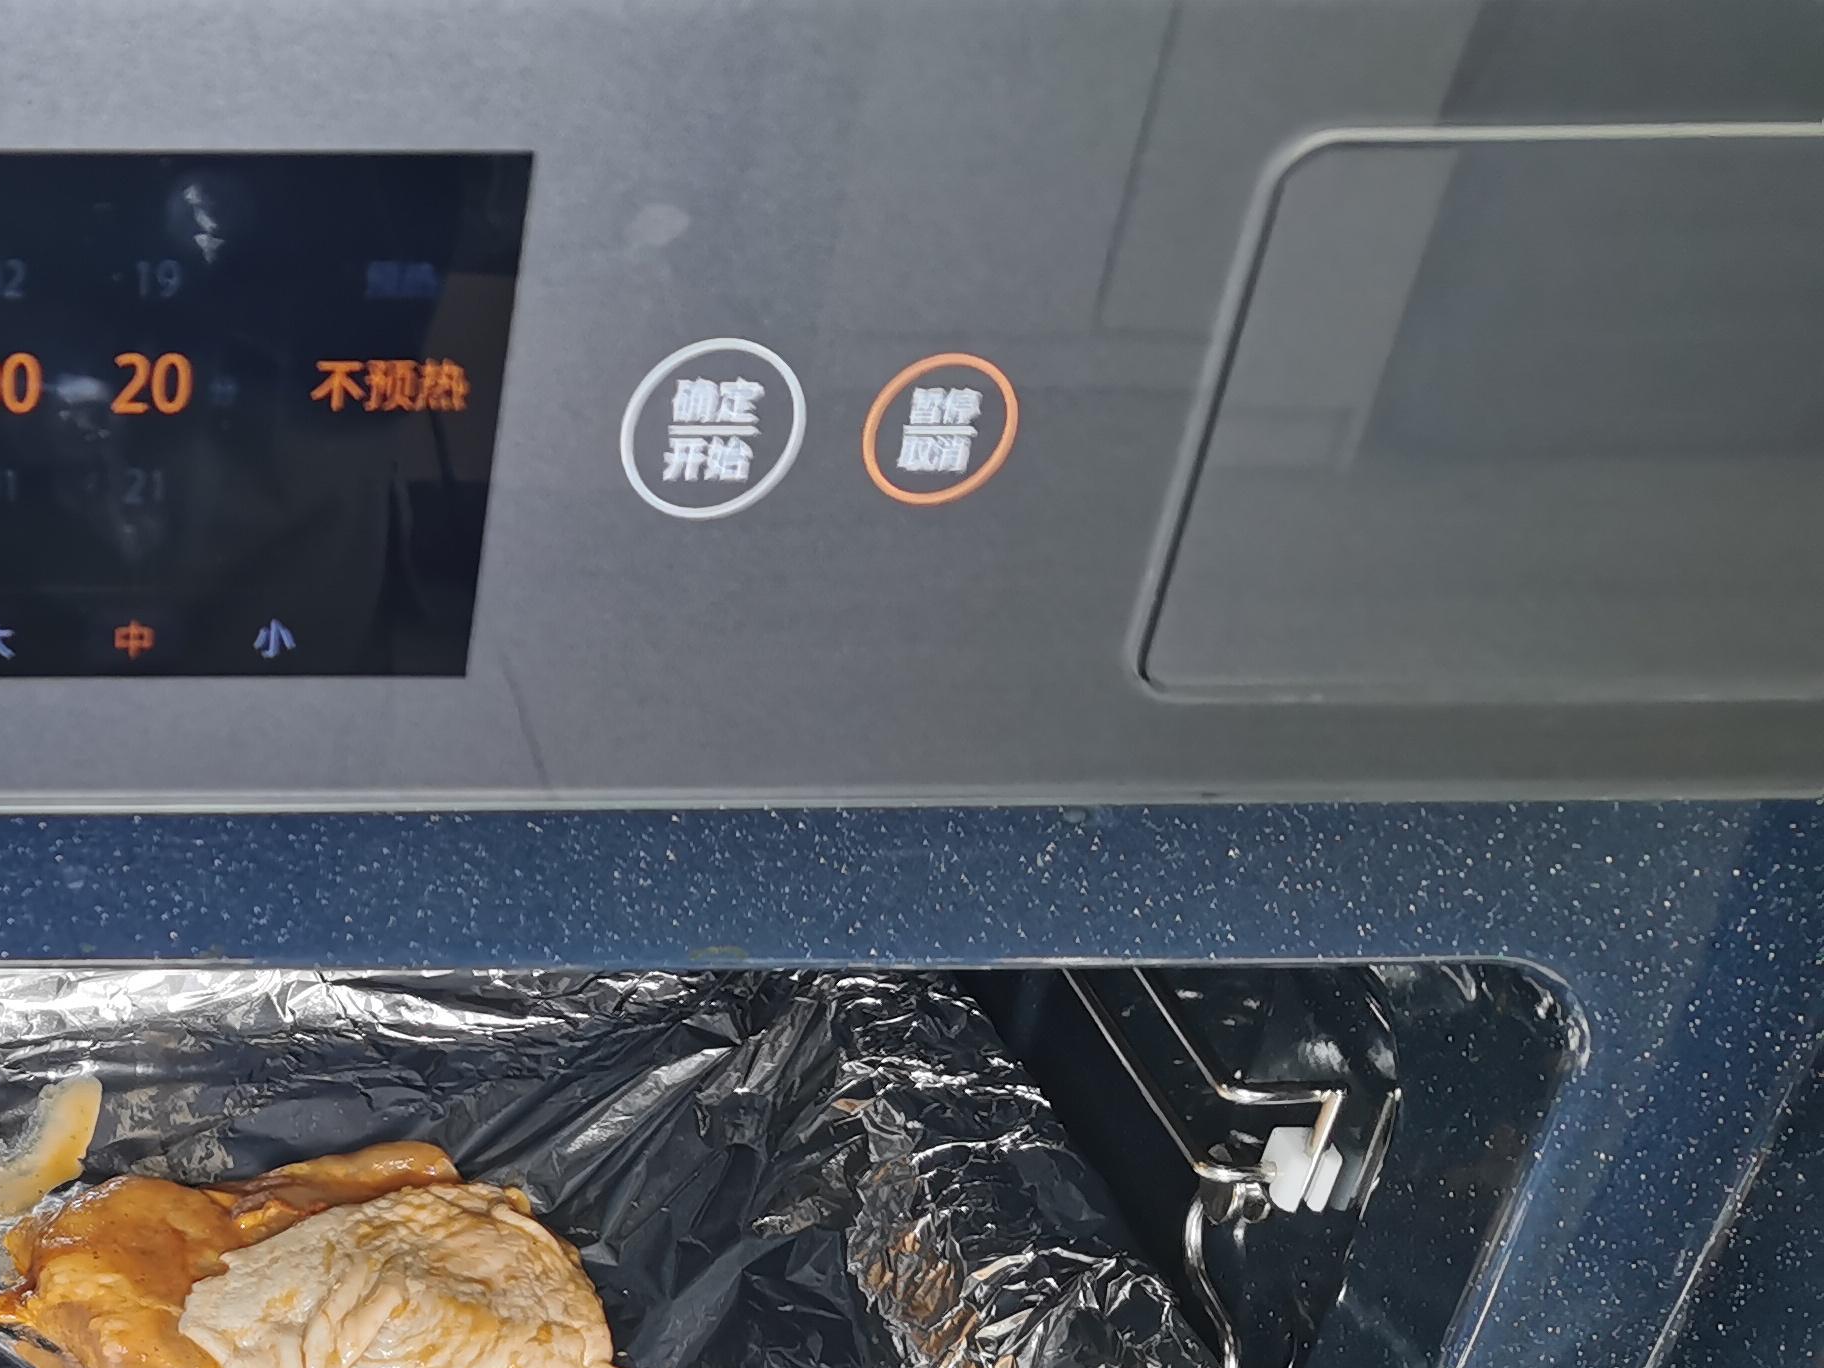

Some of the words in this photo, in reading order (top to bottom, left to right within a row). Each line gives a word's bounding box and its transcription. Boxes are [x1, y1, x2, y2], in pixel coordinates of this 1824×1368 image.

[135, 258, 182, 300] 19
[110, 350, 193, 416] 20
[309, 357, 471, 412] 不预热
[672, 377, 766, 424] 确定
[662, 436, 755, 482] 开始
[897, 435, 971, 471] 取消
[124, 468, 164, 507] 21
[114, 621, 155, 658] 中
[253, 619, 297, 659] 小
